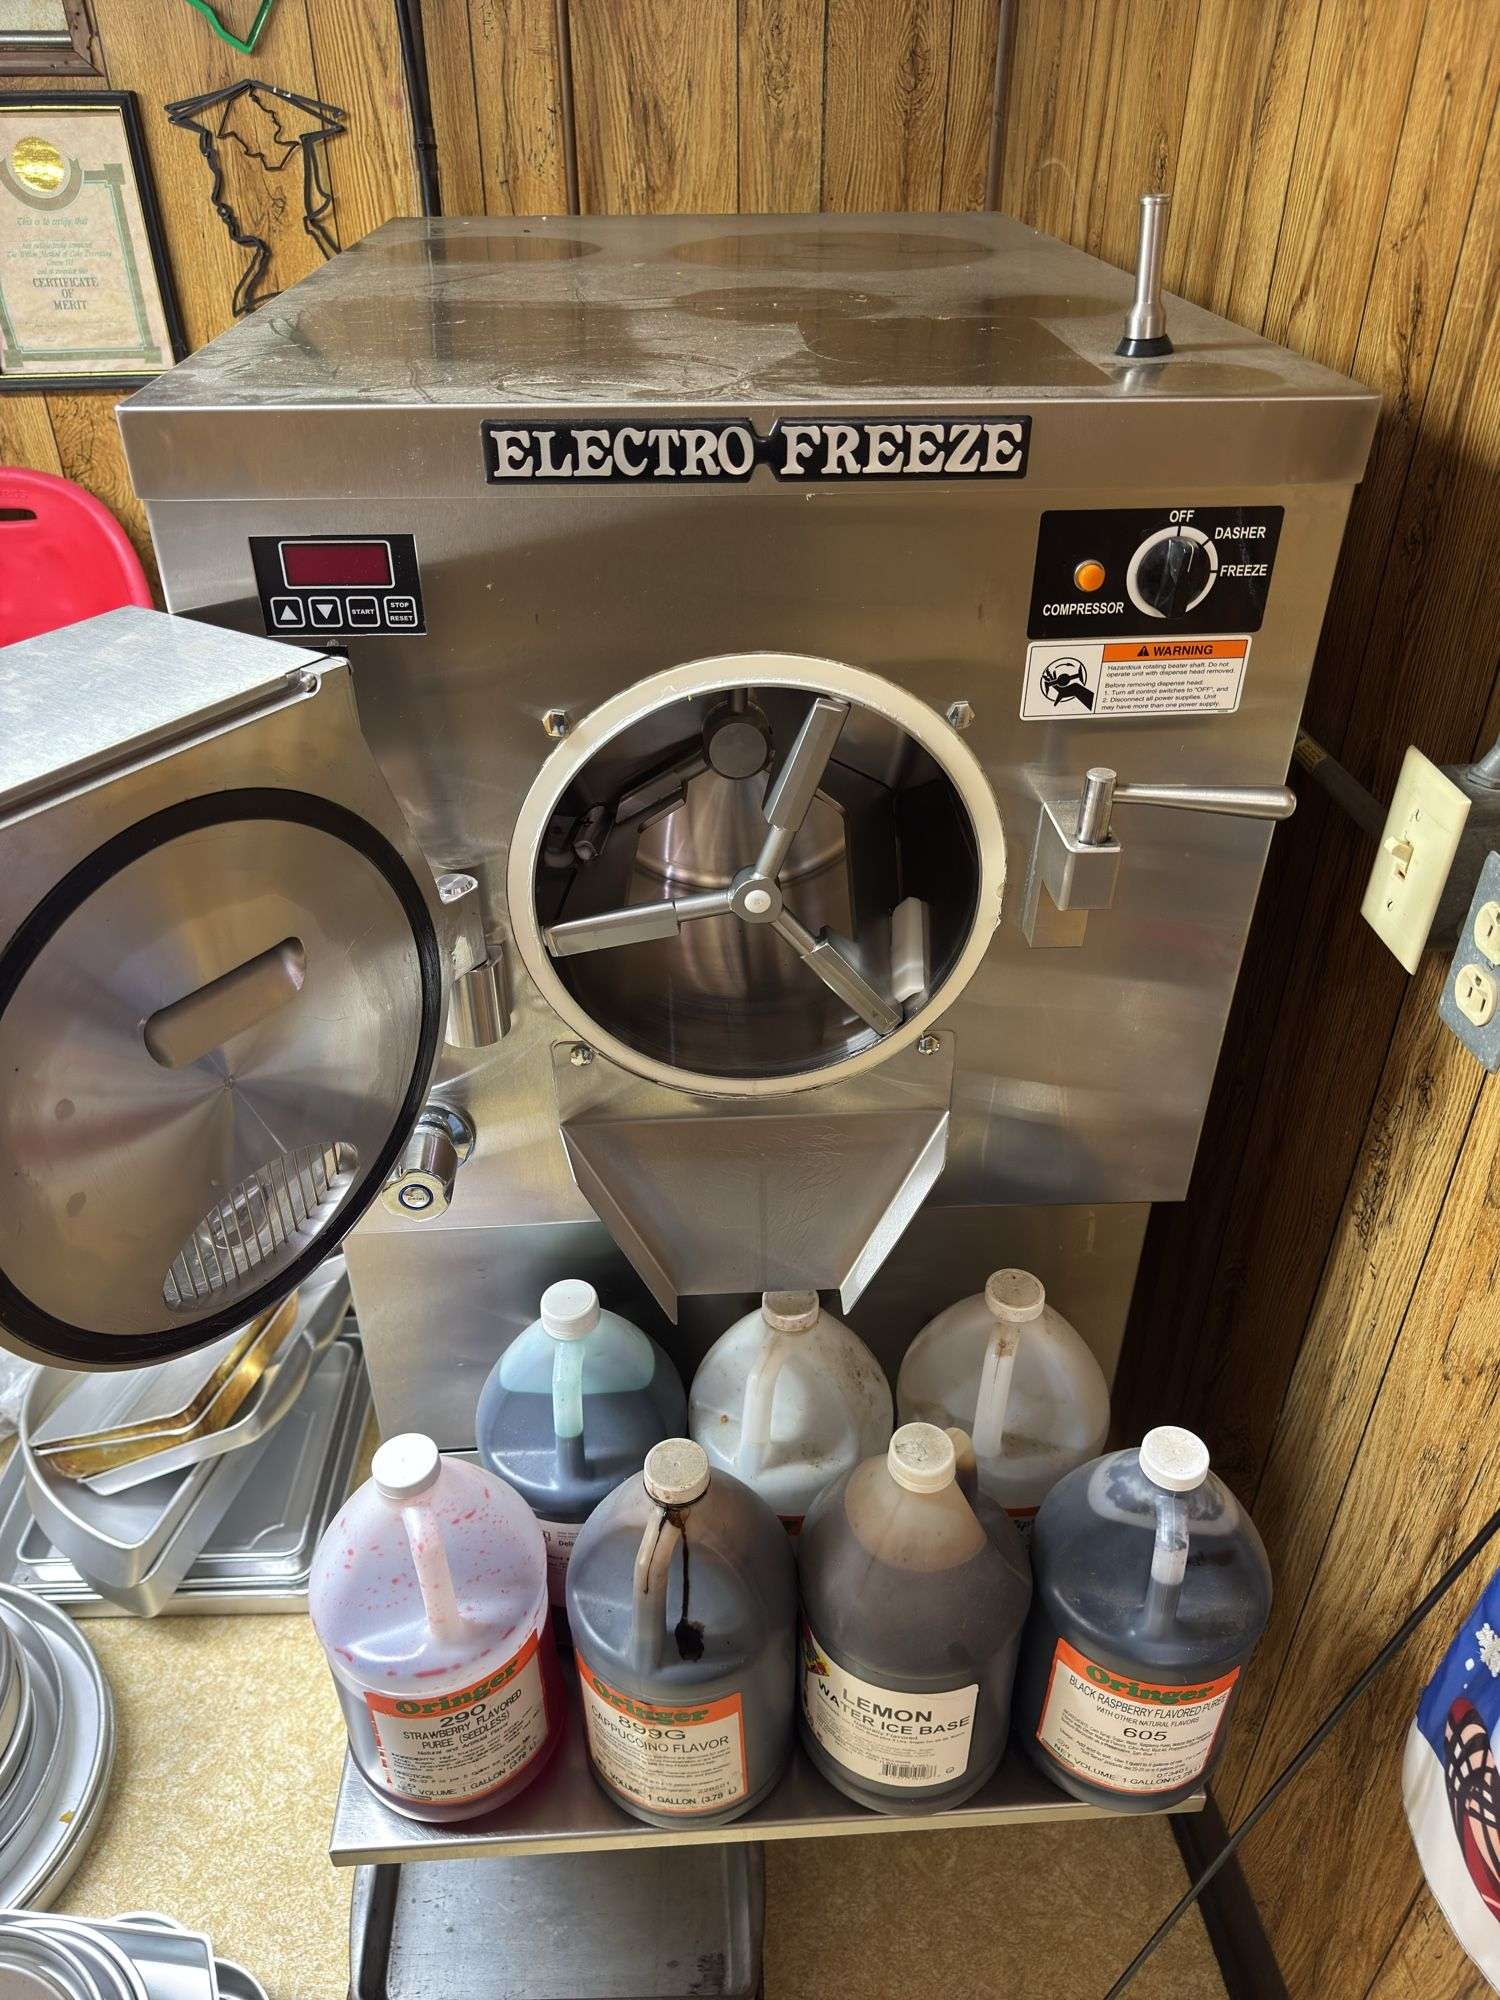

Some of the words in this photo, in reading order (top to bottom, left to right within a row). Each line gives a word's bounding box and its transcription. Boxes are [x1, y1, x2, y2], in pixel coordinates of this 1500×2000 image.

[32, 277, 99, 288] CERTIFICATE
[61, 288, 74, 298] OF
[53, 300, 88, 310] MERIT
[489, 426, 756, 479] ELECTRO
[779, 423, 1025, 475] FREEZE
[1169, 509, 1196, 523] OFF
[1214, 525, 1267, 540] DASHER
[1219, 564, 1268, 578] FREEZE
[1042, 601, 1125, 617] COMPRESSOR
[1153, 644, 1214, 657] WARNING
[1142, 663, 1167, 671] rotating
[395, 1659, 520, 1715] Oringer
[1085, 1664, 1214, 1705] Oringer
[592, 1678, 710, 1726] Oringer
[842, 1687, 933, 1723] LEMON
[1068, 1674, 1097, 1701] BLACK
[1096, 1692, 1154, 1718] RASPBERRY
[1154, 1705, 1201, 1719] FLAVORED
[403, 1720, 472, 1740] STRAWBERRY
[475, 1688, 523, 1726] FLAVORED
[439, 1702, 488, 1728] 290
[818, 1678, 875, 1727] WATER
[881, 1721, 913, 1735] ICE
[919, 1715, 971, 1736] BASE
[618, 1715, 687, 1741] 899G
[1114, 1713, 1138, 1725] OTHER
[1138, 1719, 1169, 1728] NATURAL
[1170, 1716, 1200, 1728] FLAVORS
[421, 1738, 455, 1749] PUREE
[458, 1711, 511, 1745] (SEEDLESS)
[1123, 1727, 1168, 1742] 605
[672, 1735, 729, 1754] FLAVOR
[1053, 1743, 1072, 1758] NET
[470, 1768, 506, 1790] GALLON
[657, 1796, 697, 1805] GALLON
